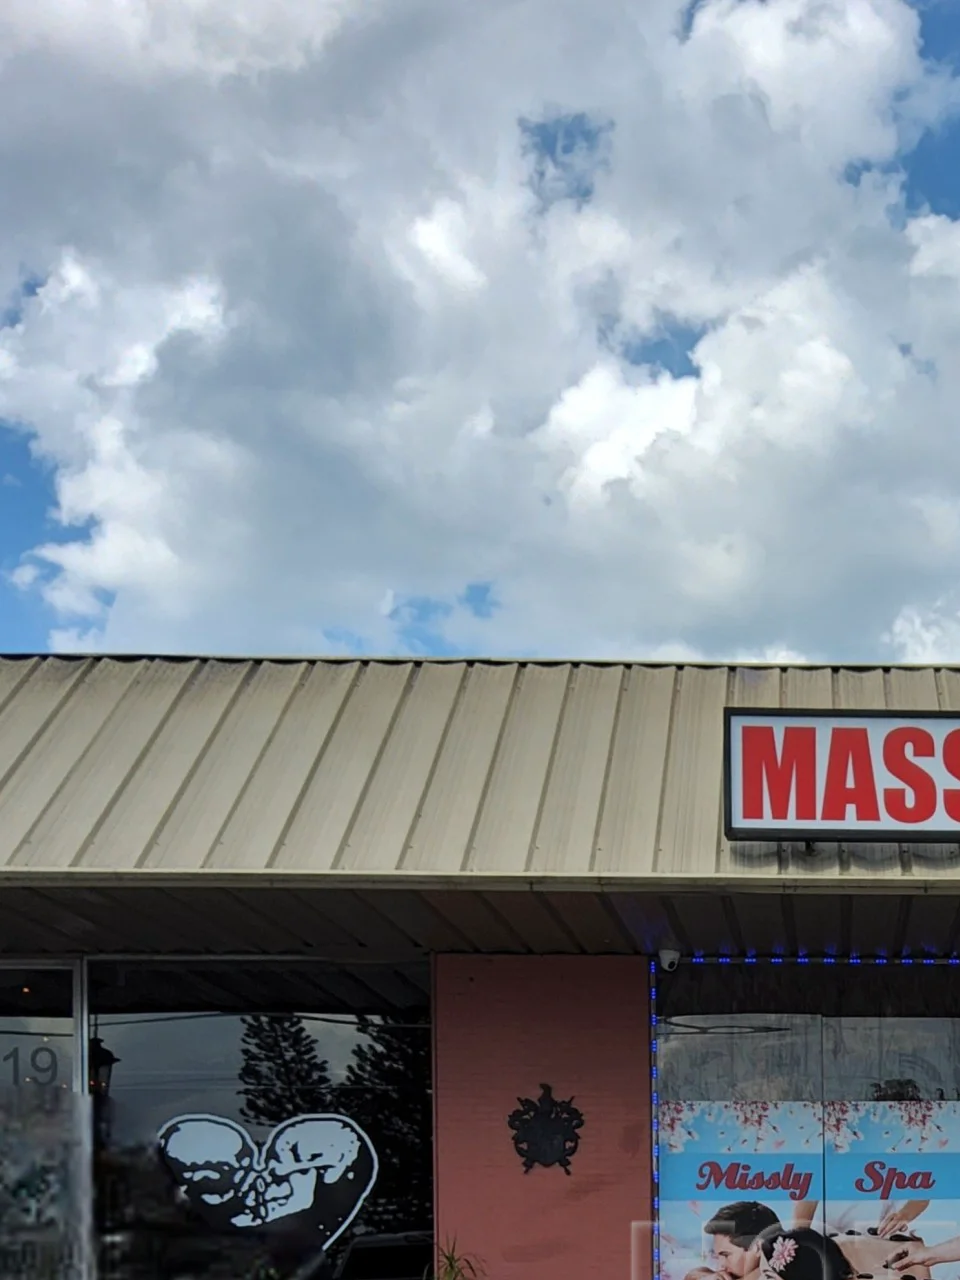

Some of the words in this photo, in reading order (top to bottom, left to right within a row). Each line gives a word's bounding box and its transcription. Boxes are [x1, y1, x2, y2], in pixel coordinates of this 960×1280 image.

[3, 1046, 58, 1087] 19
[696, 1161, 814, 1200] Missly
[855, 1161, 936, 1200] Spa
